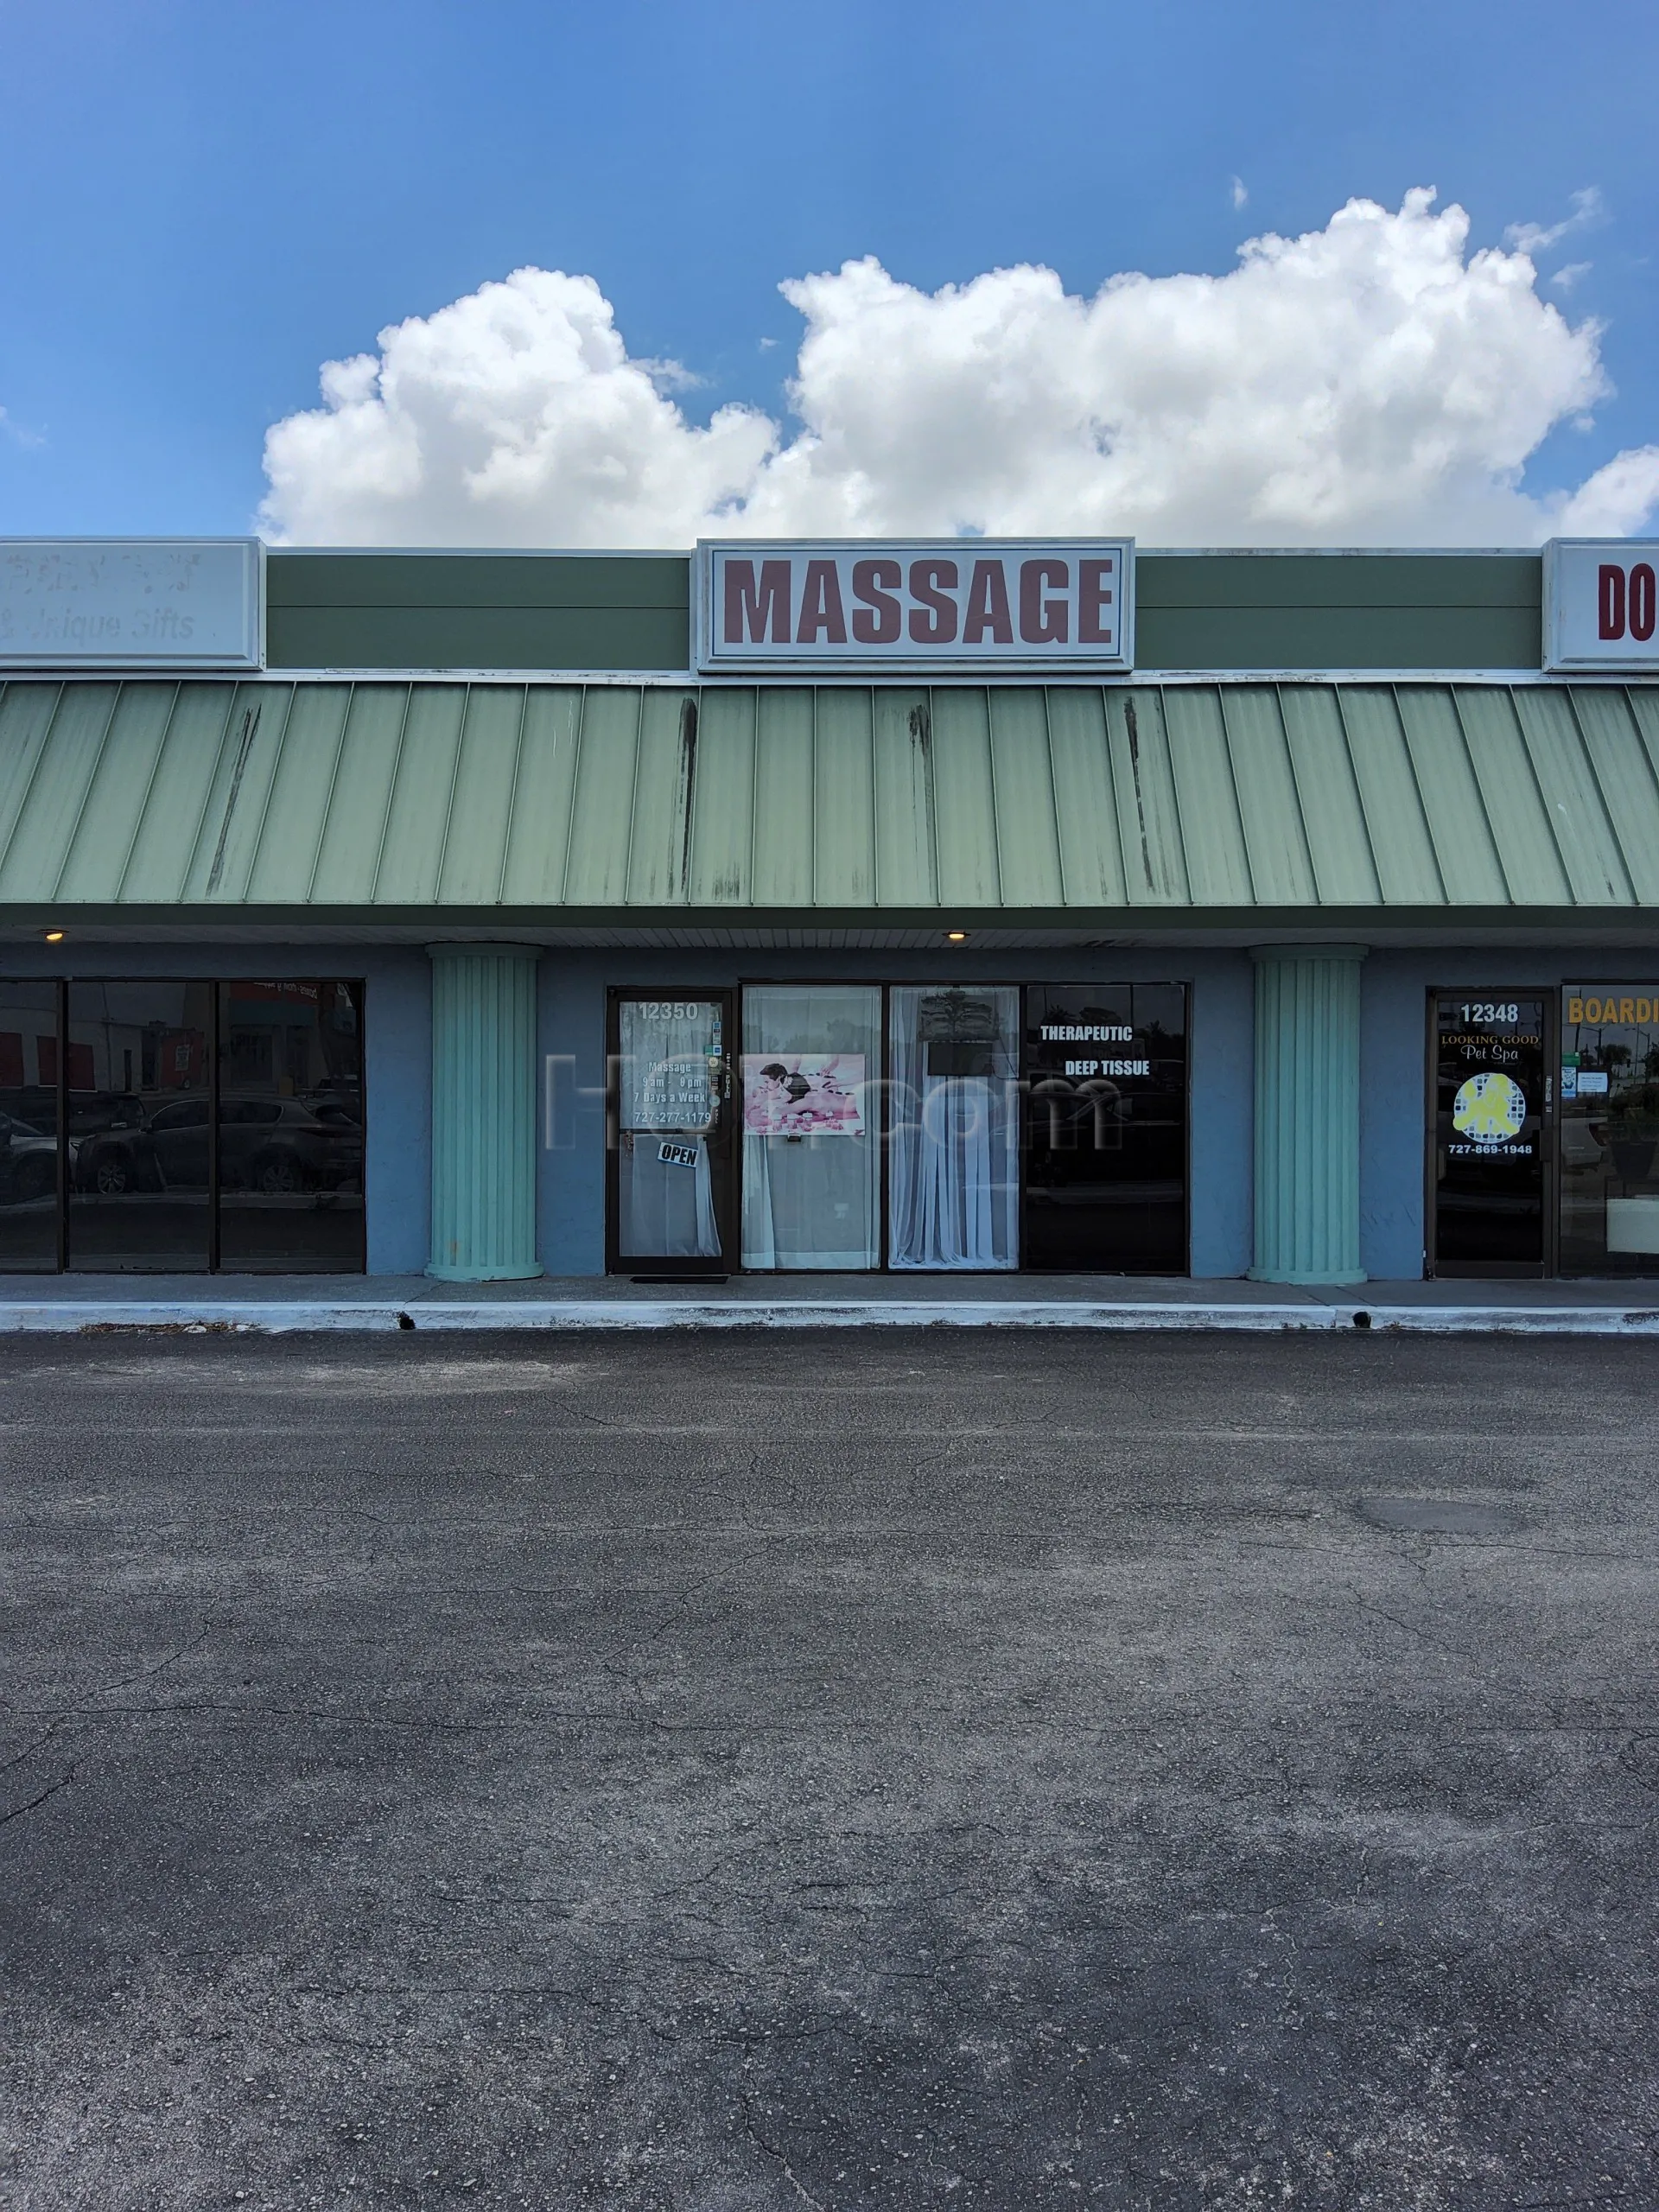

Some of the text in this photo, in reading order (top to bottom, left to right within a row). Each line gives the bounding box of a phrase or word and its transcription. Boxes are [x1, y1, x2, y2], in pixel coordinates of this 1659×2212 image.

[724, 559, 1113, 645] MASSAGE
[1599, 563, 1656, 642] DO
[639, 1002, 699, 1020] 12350
[1460, 1003, 1519, 1022] 12348
[1568, 997, 1659, 1024] BOARDI
[1039, 1025, 1133, 1042] THERAPEUTIC
[1441, 1035, 1539, 1045] LOOKING GOOD
[1460, 1044, 1519, 1064] Pet Spa
[648, 1061, 691, 1074] Massage
[1065, 1059, 1150, 1076] DEEP TISSUE
[633, 1091, 705, 1104] 7 Days a Week
[634, 1111, 712, 1123] 727-277-1179
[660, 1143, 697, 1166] OPEN
[1448, 1144, 1533, 1154] 727-869-1948
